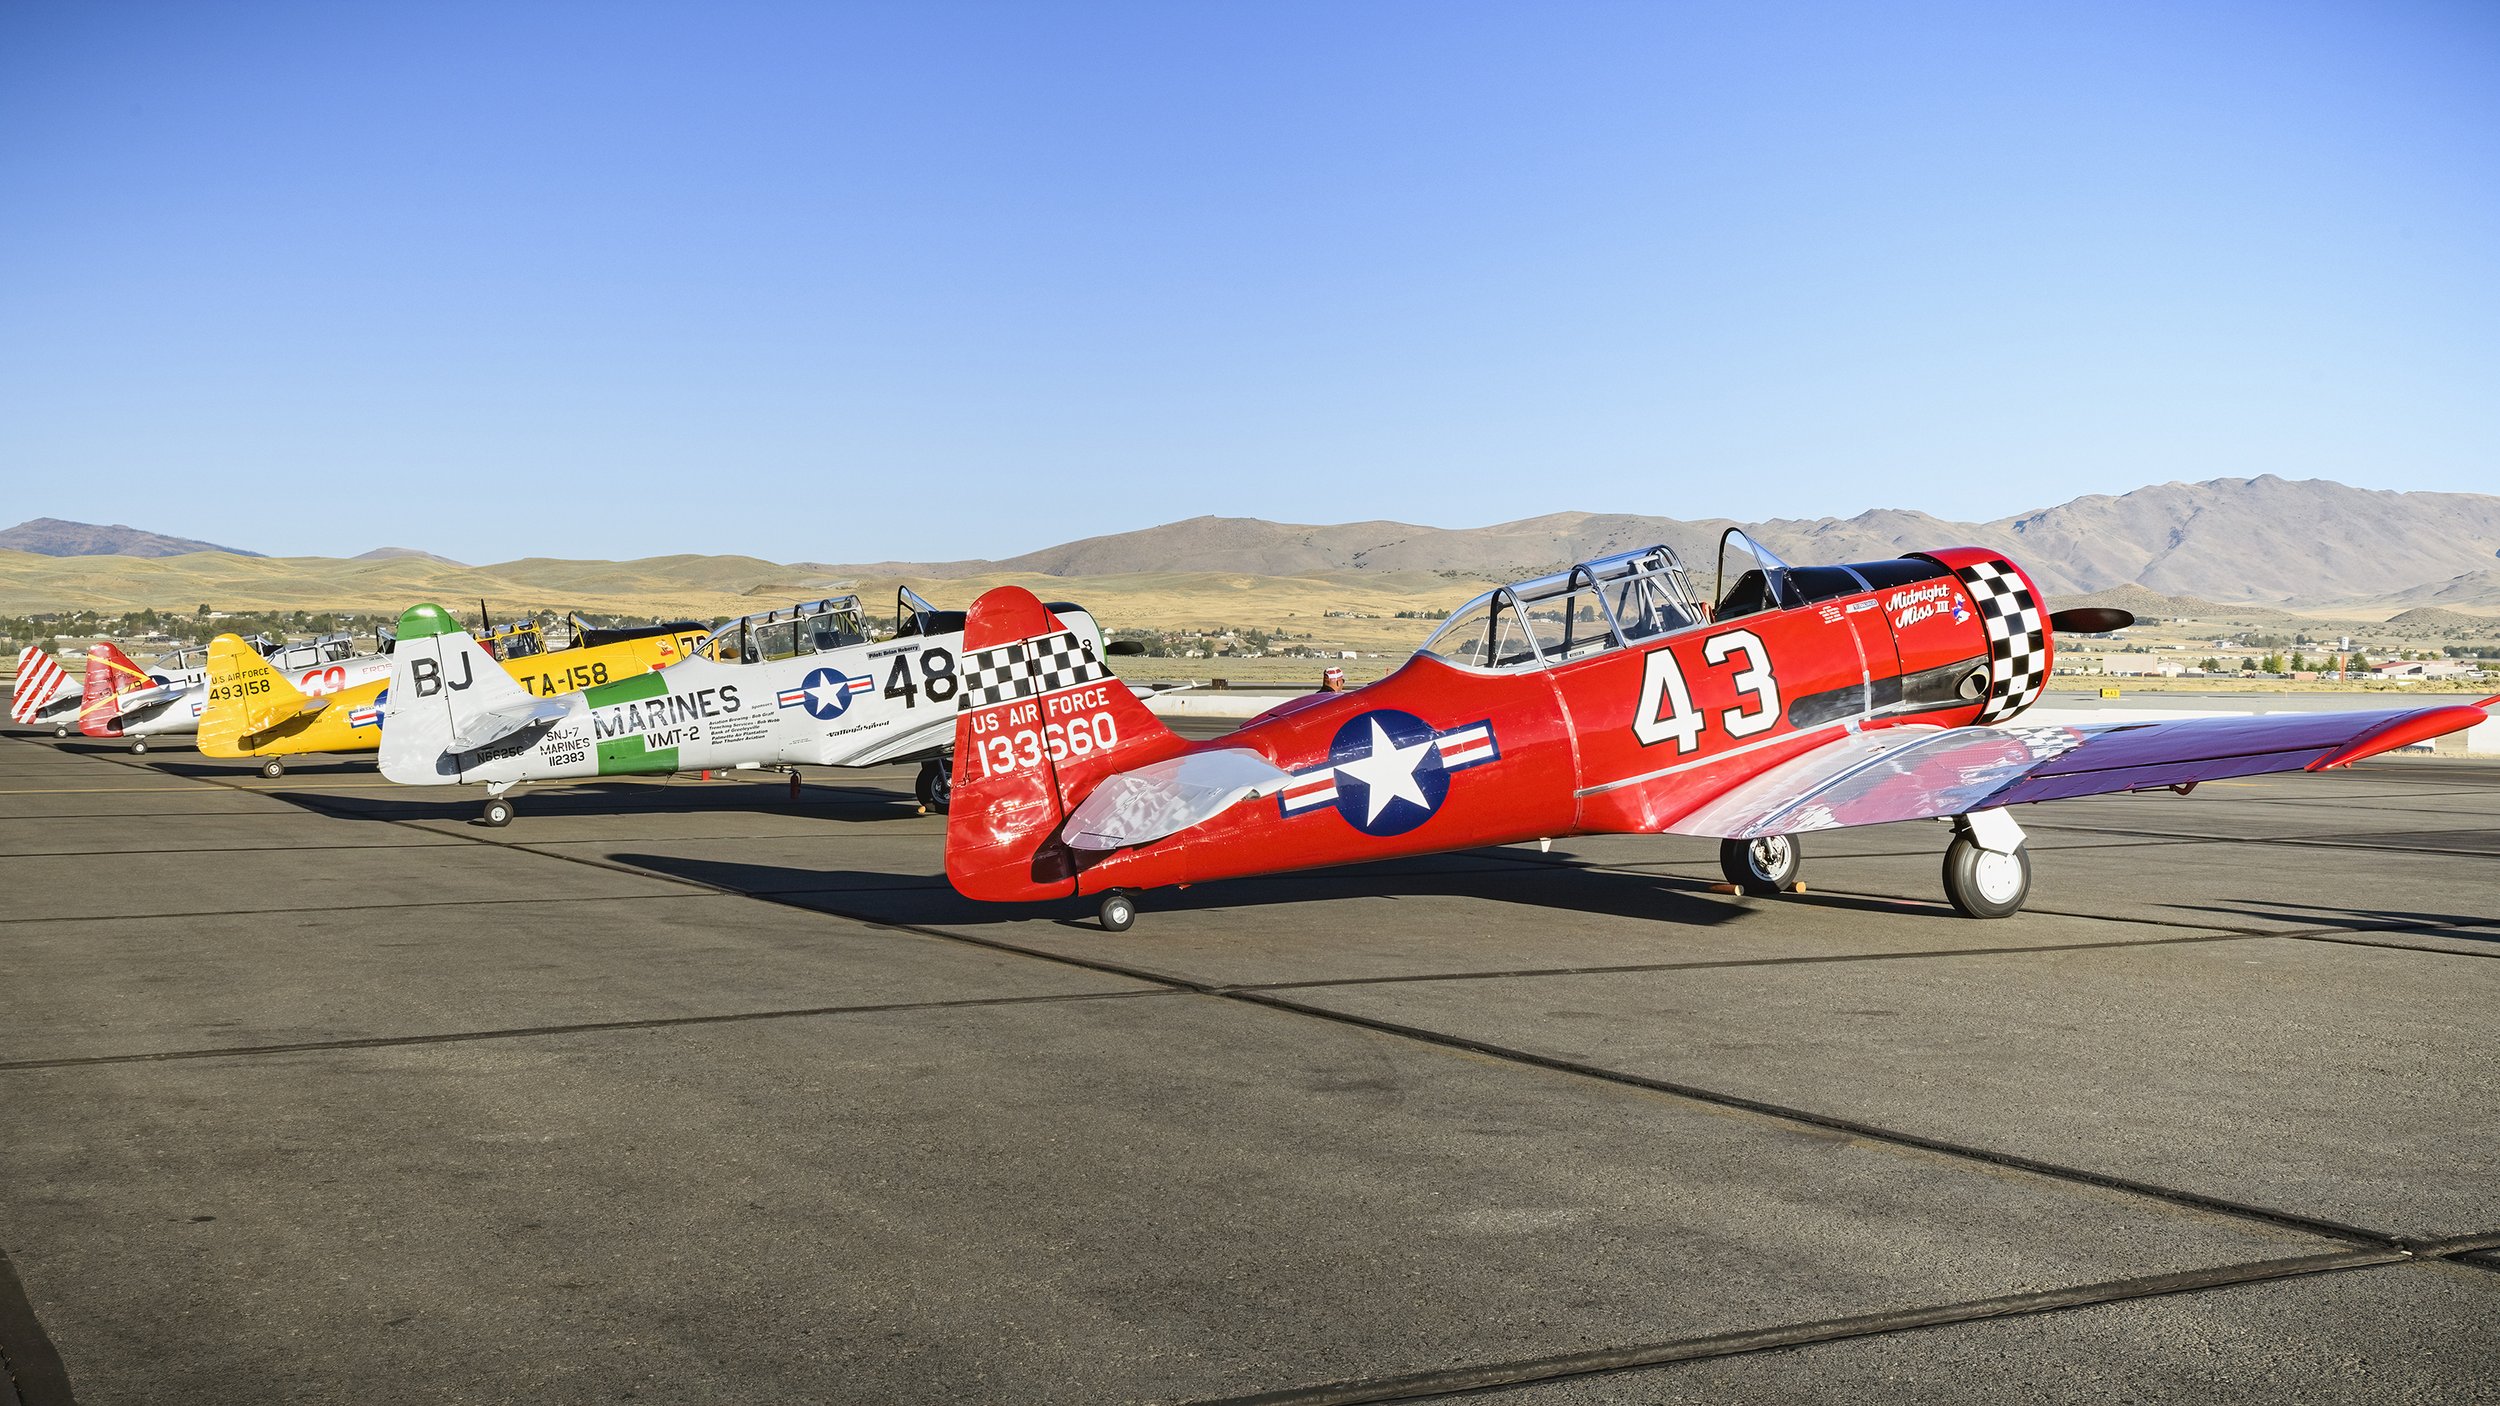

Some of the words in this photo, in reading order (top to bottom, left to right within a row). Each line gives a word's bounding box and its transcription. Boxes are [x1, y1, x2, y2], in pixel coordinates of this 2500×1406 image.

[1885, 584, 1950, 612] Midnight
[1895, 604, 1934, 628] Miss
[1935, 600, 1950, 613] III
[228, 672, 240, 681] AIR
[242, 667, 270, 678] FORCE
[411, 651, 474, 698] BJ
[520, 662, 608, 696] TA-158
[884, 647, 959, 709] 48
[210, 679, 271, 700] 493158
[1631, 628, 1783, 756] 43
[592, 685, 741, 740] MARINES
[971, 712, 1000, 734] US
[1009, 703, 1039, 727] AIR
[1048, 687, 1110, 717] FORCE
[540, 738, 590, 756] MARINES
[546, 727, 579, 741] SNJ-7
[647, 726, 700, 748] VMT-2
[549, 752, 586, 767] 112383
